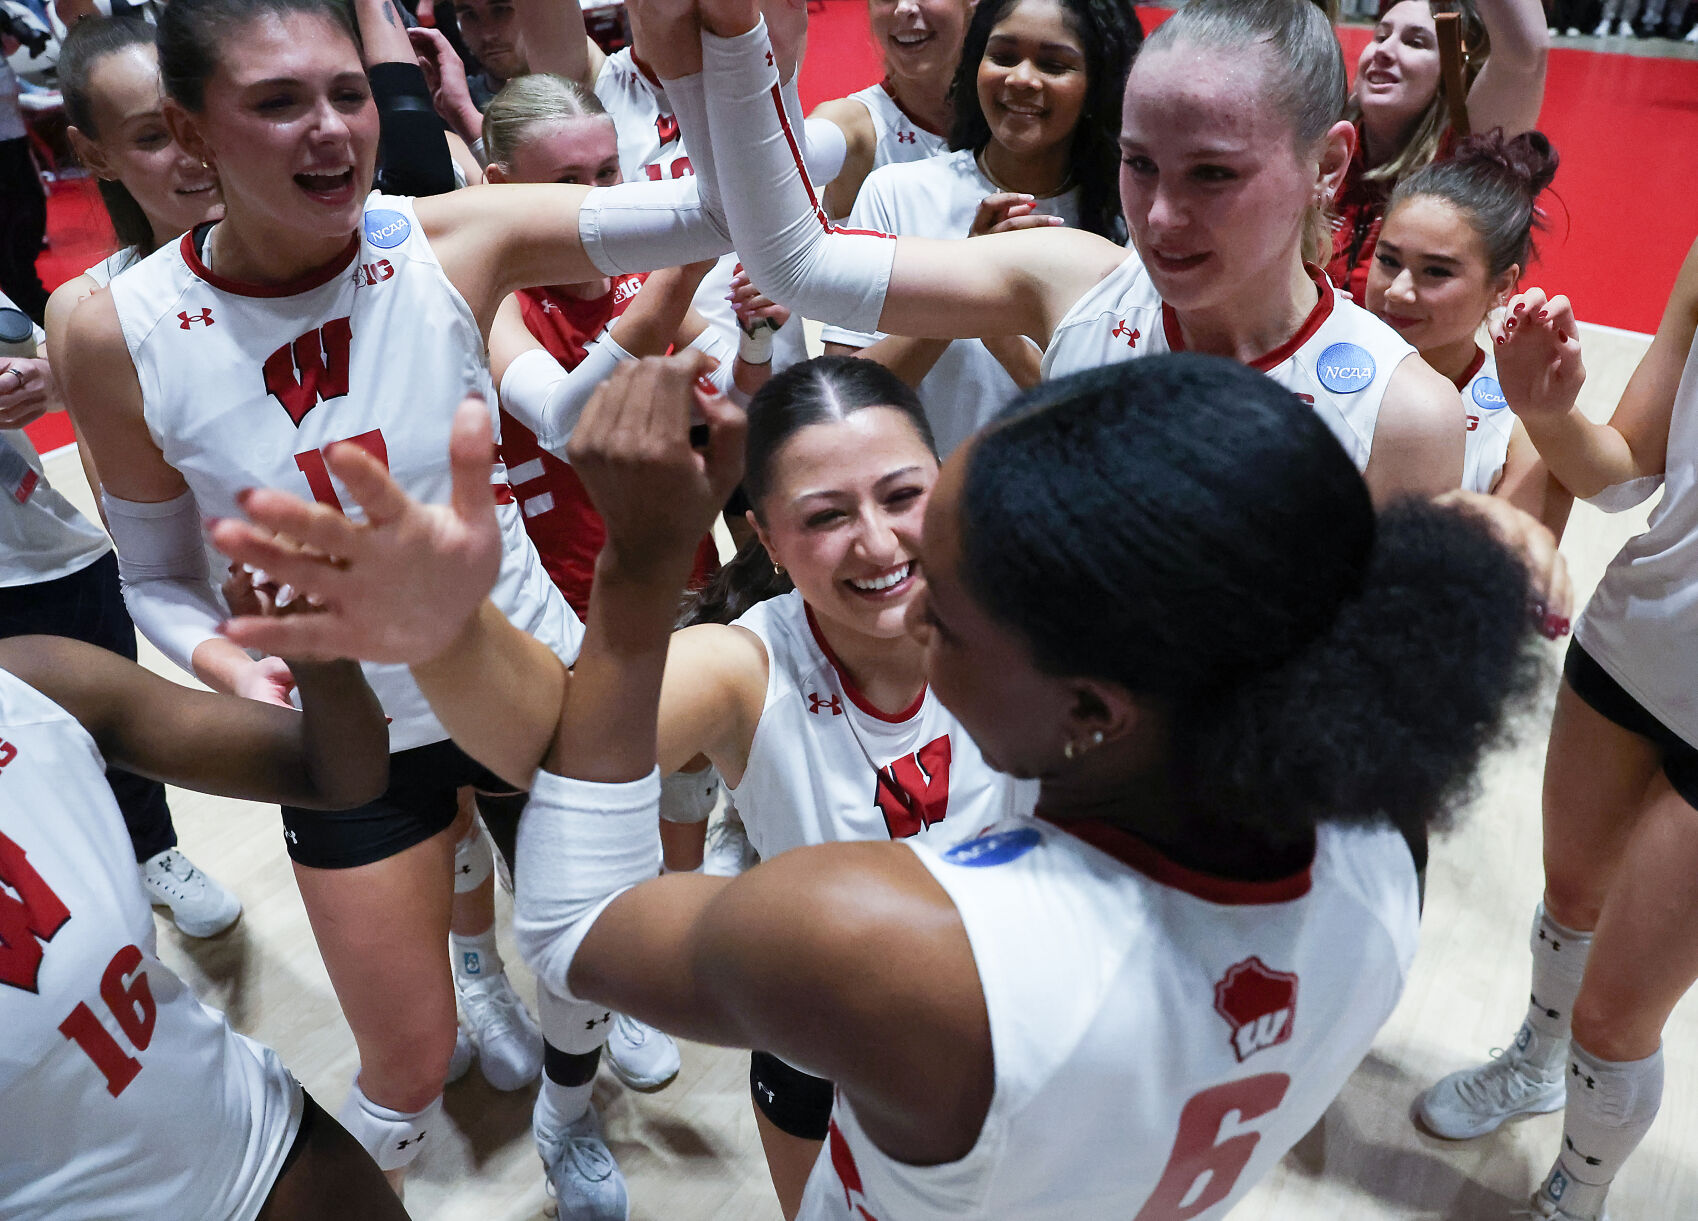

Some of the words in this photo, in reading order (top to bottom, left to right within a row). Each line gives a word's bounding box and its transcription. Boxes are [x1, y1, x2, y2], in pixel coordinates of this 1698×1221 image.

[370, 218, 409, 242] NCAA
[1325, 366, 1373, 379] NCAA
[1476, 389, 1506, 403] NCA
[57, 945, 157, 1099] 16
[1132, 1072, 1291, 1221] 6
